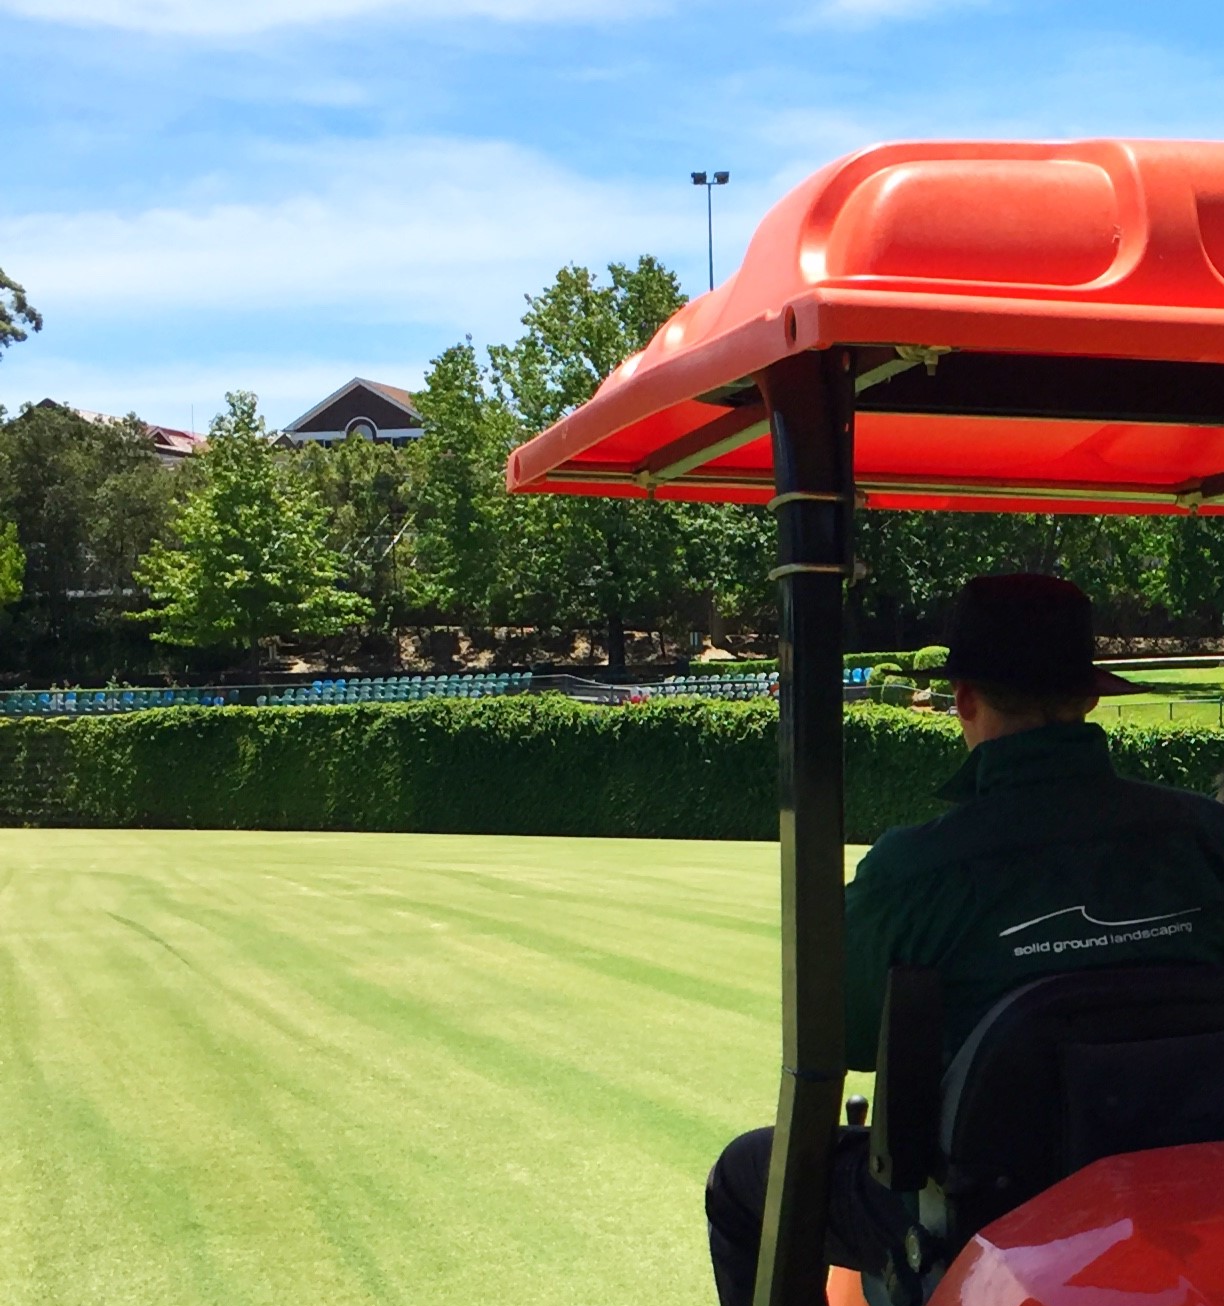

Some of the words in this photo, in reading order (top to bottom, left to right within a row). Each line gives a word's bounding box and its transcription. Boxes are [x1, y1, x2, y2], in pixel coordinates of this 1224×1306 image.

[1013, 941, 1050, 957] solid
[1053, 935, 1108, 953] ground
[1110, 921, 1192, 944] landscaping
